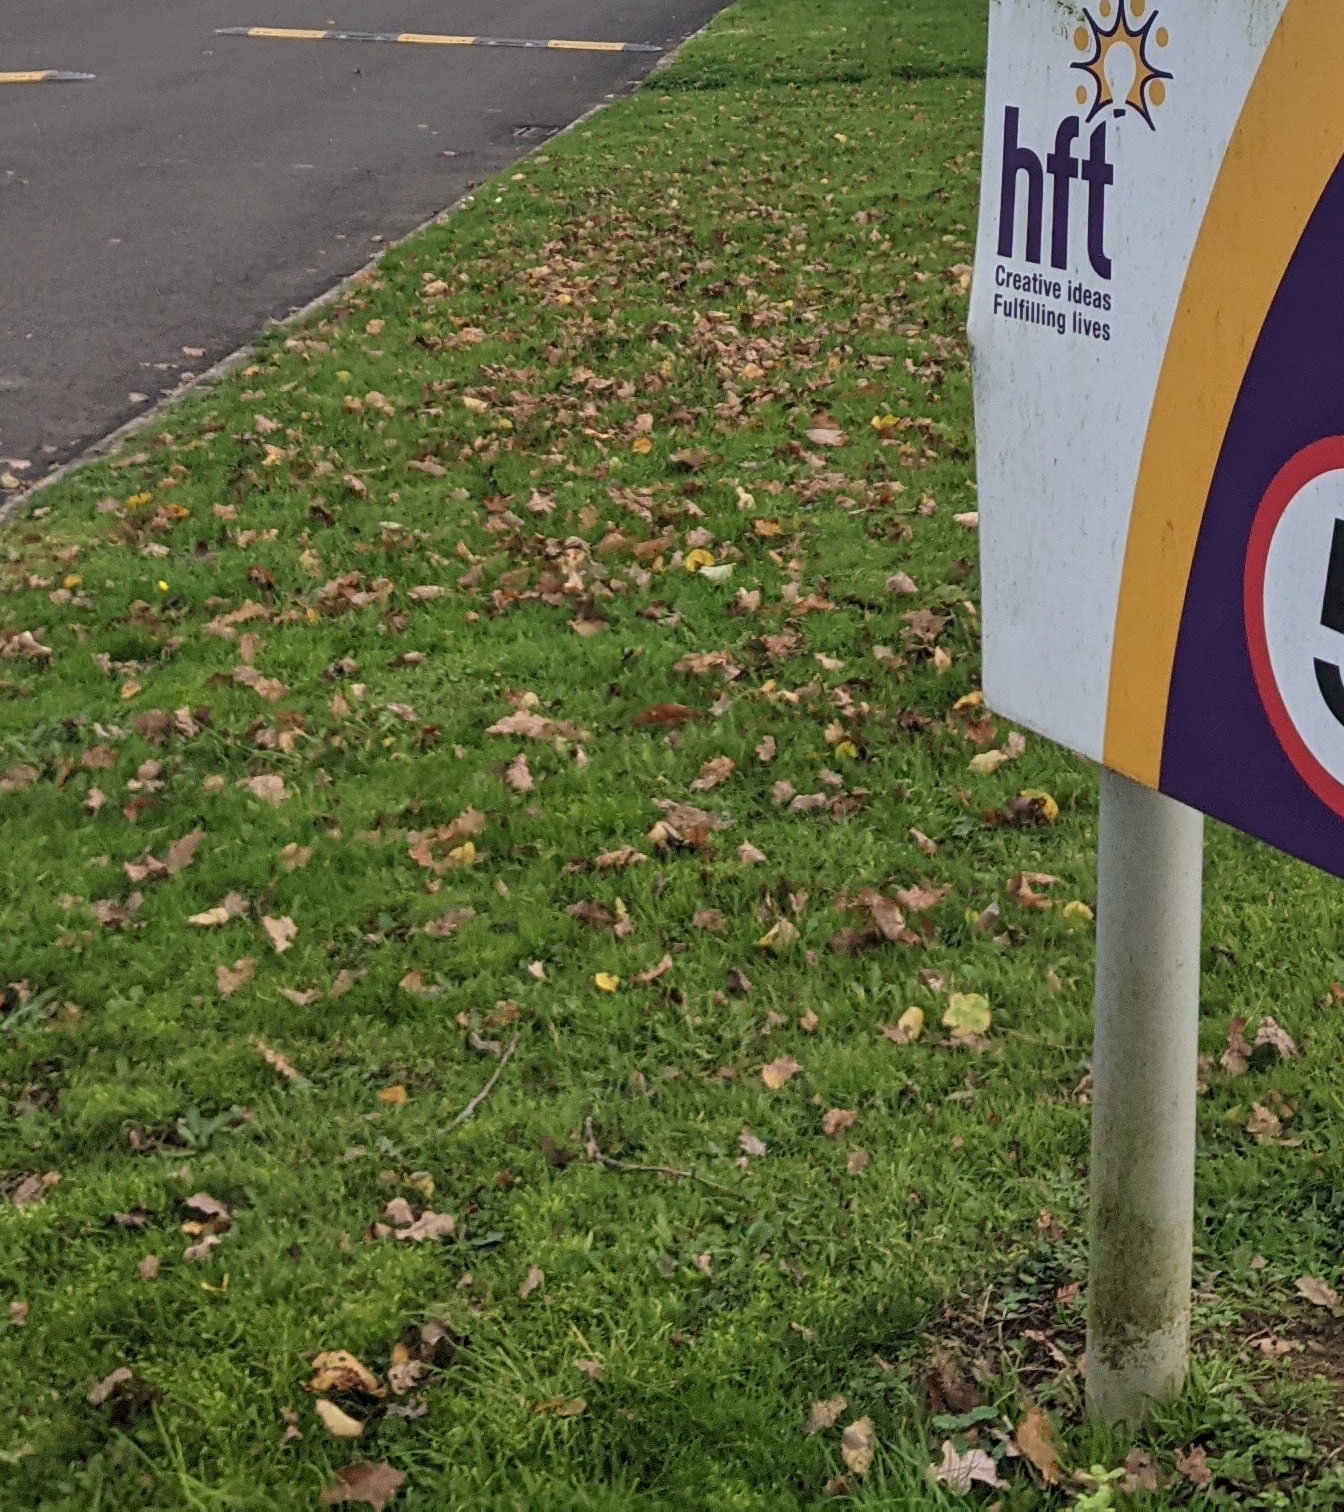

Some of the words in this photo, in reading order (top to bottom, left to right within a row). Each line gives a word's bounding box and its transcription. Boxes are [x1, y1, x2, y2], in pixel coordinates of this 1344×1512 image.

[996, 105, 1114, 281] hft
[995, 264, 1062, 300] Creative
[1067, 279, 1112, 311] ideas
[993, 292, 1066, 335] Fulfilling
[1072, 310, 1111, 341] lives
